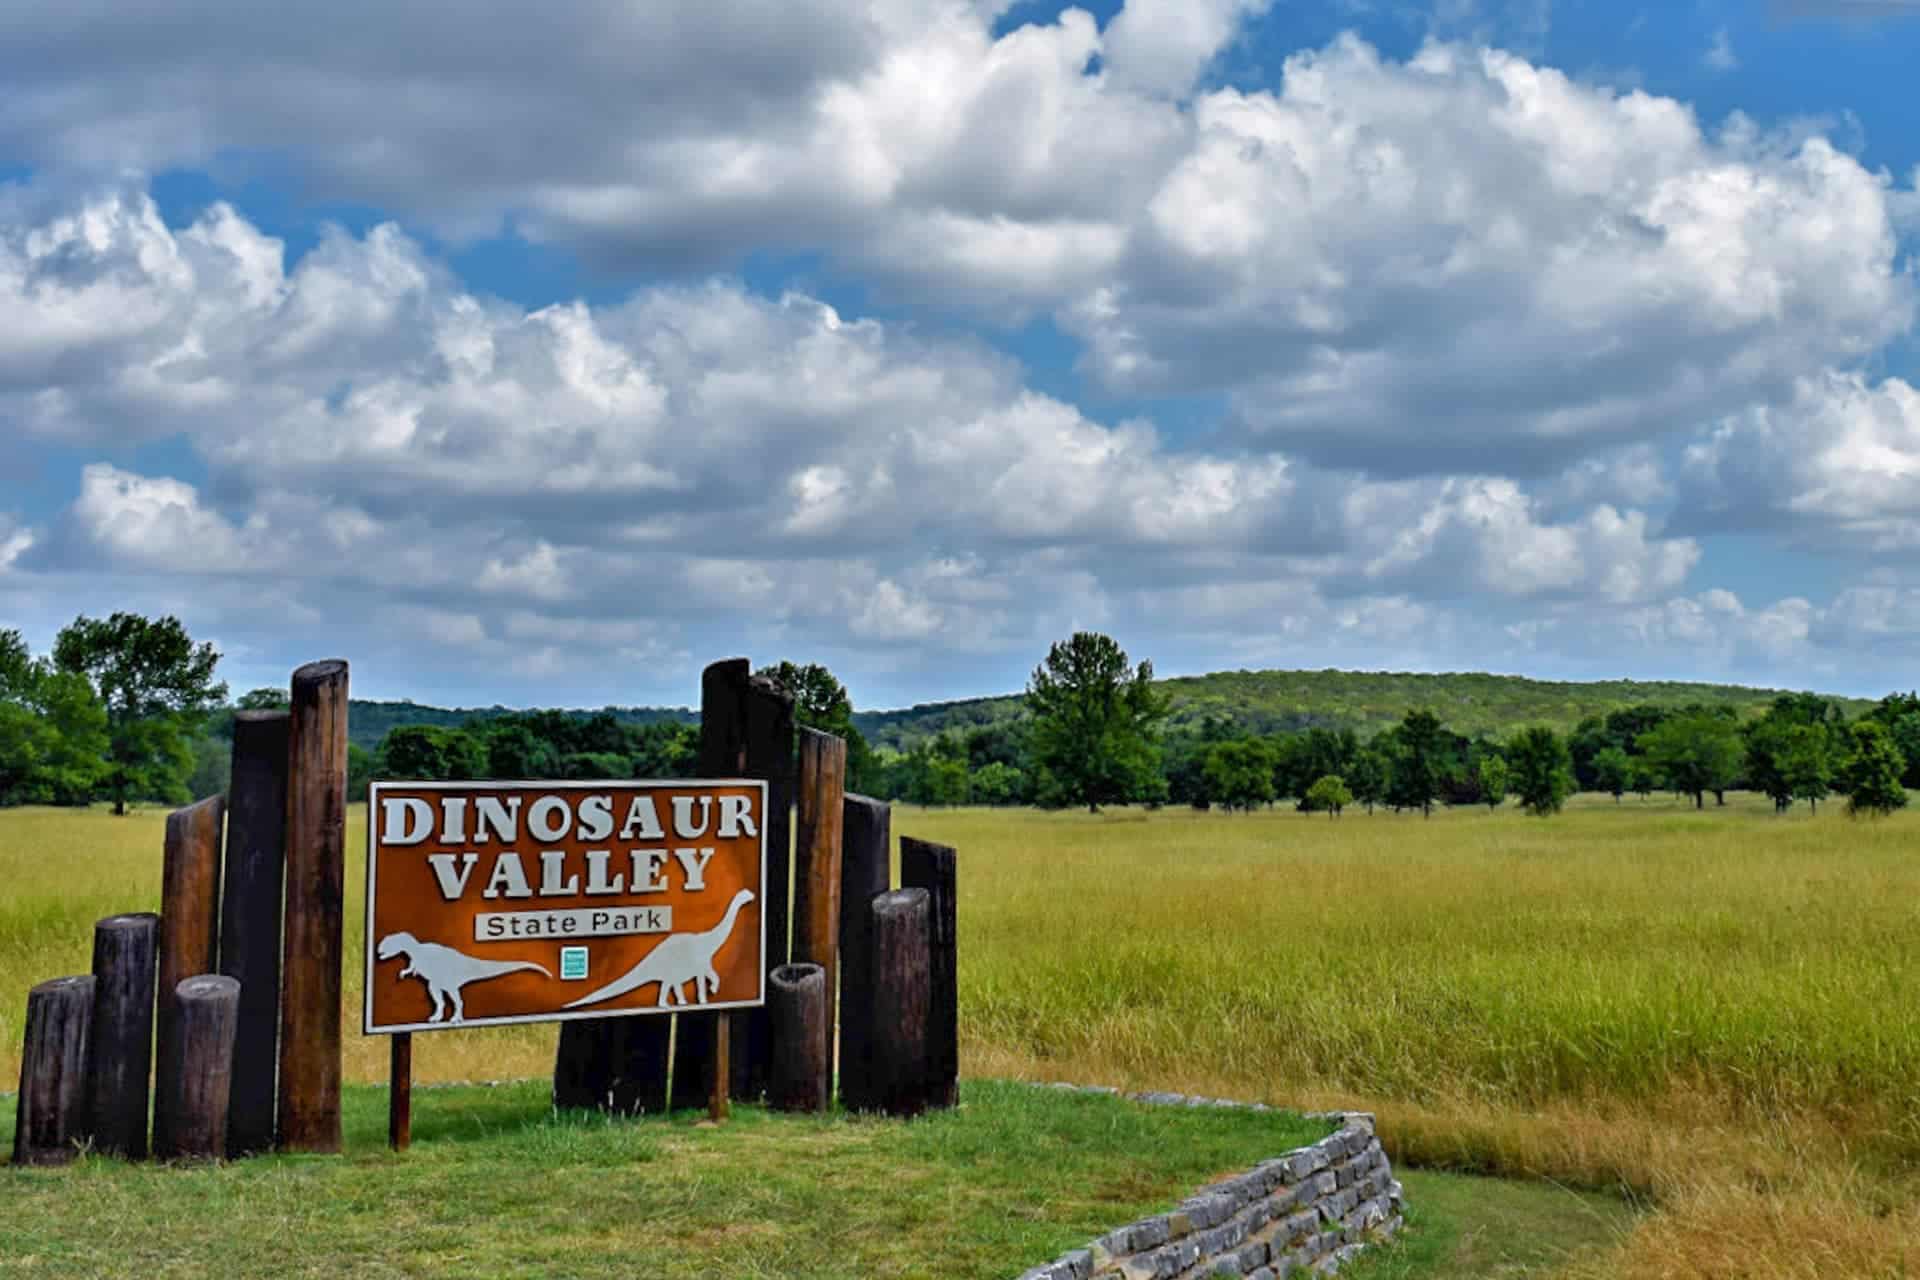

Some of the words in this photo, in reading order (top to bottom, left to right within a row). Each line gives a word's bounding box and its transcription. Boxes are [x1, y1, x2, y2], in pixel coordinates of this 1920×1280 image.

[381, 795, 758, 844] DINOSAUR
[428, 847, 715, 899] VALLEY
[487, 916, 576, 937] State
[592, 909, 663, 932] Park
